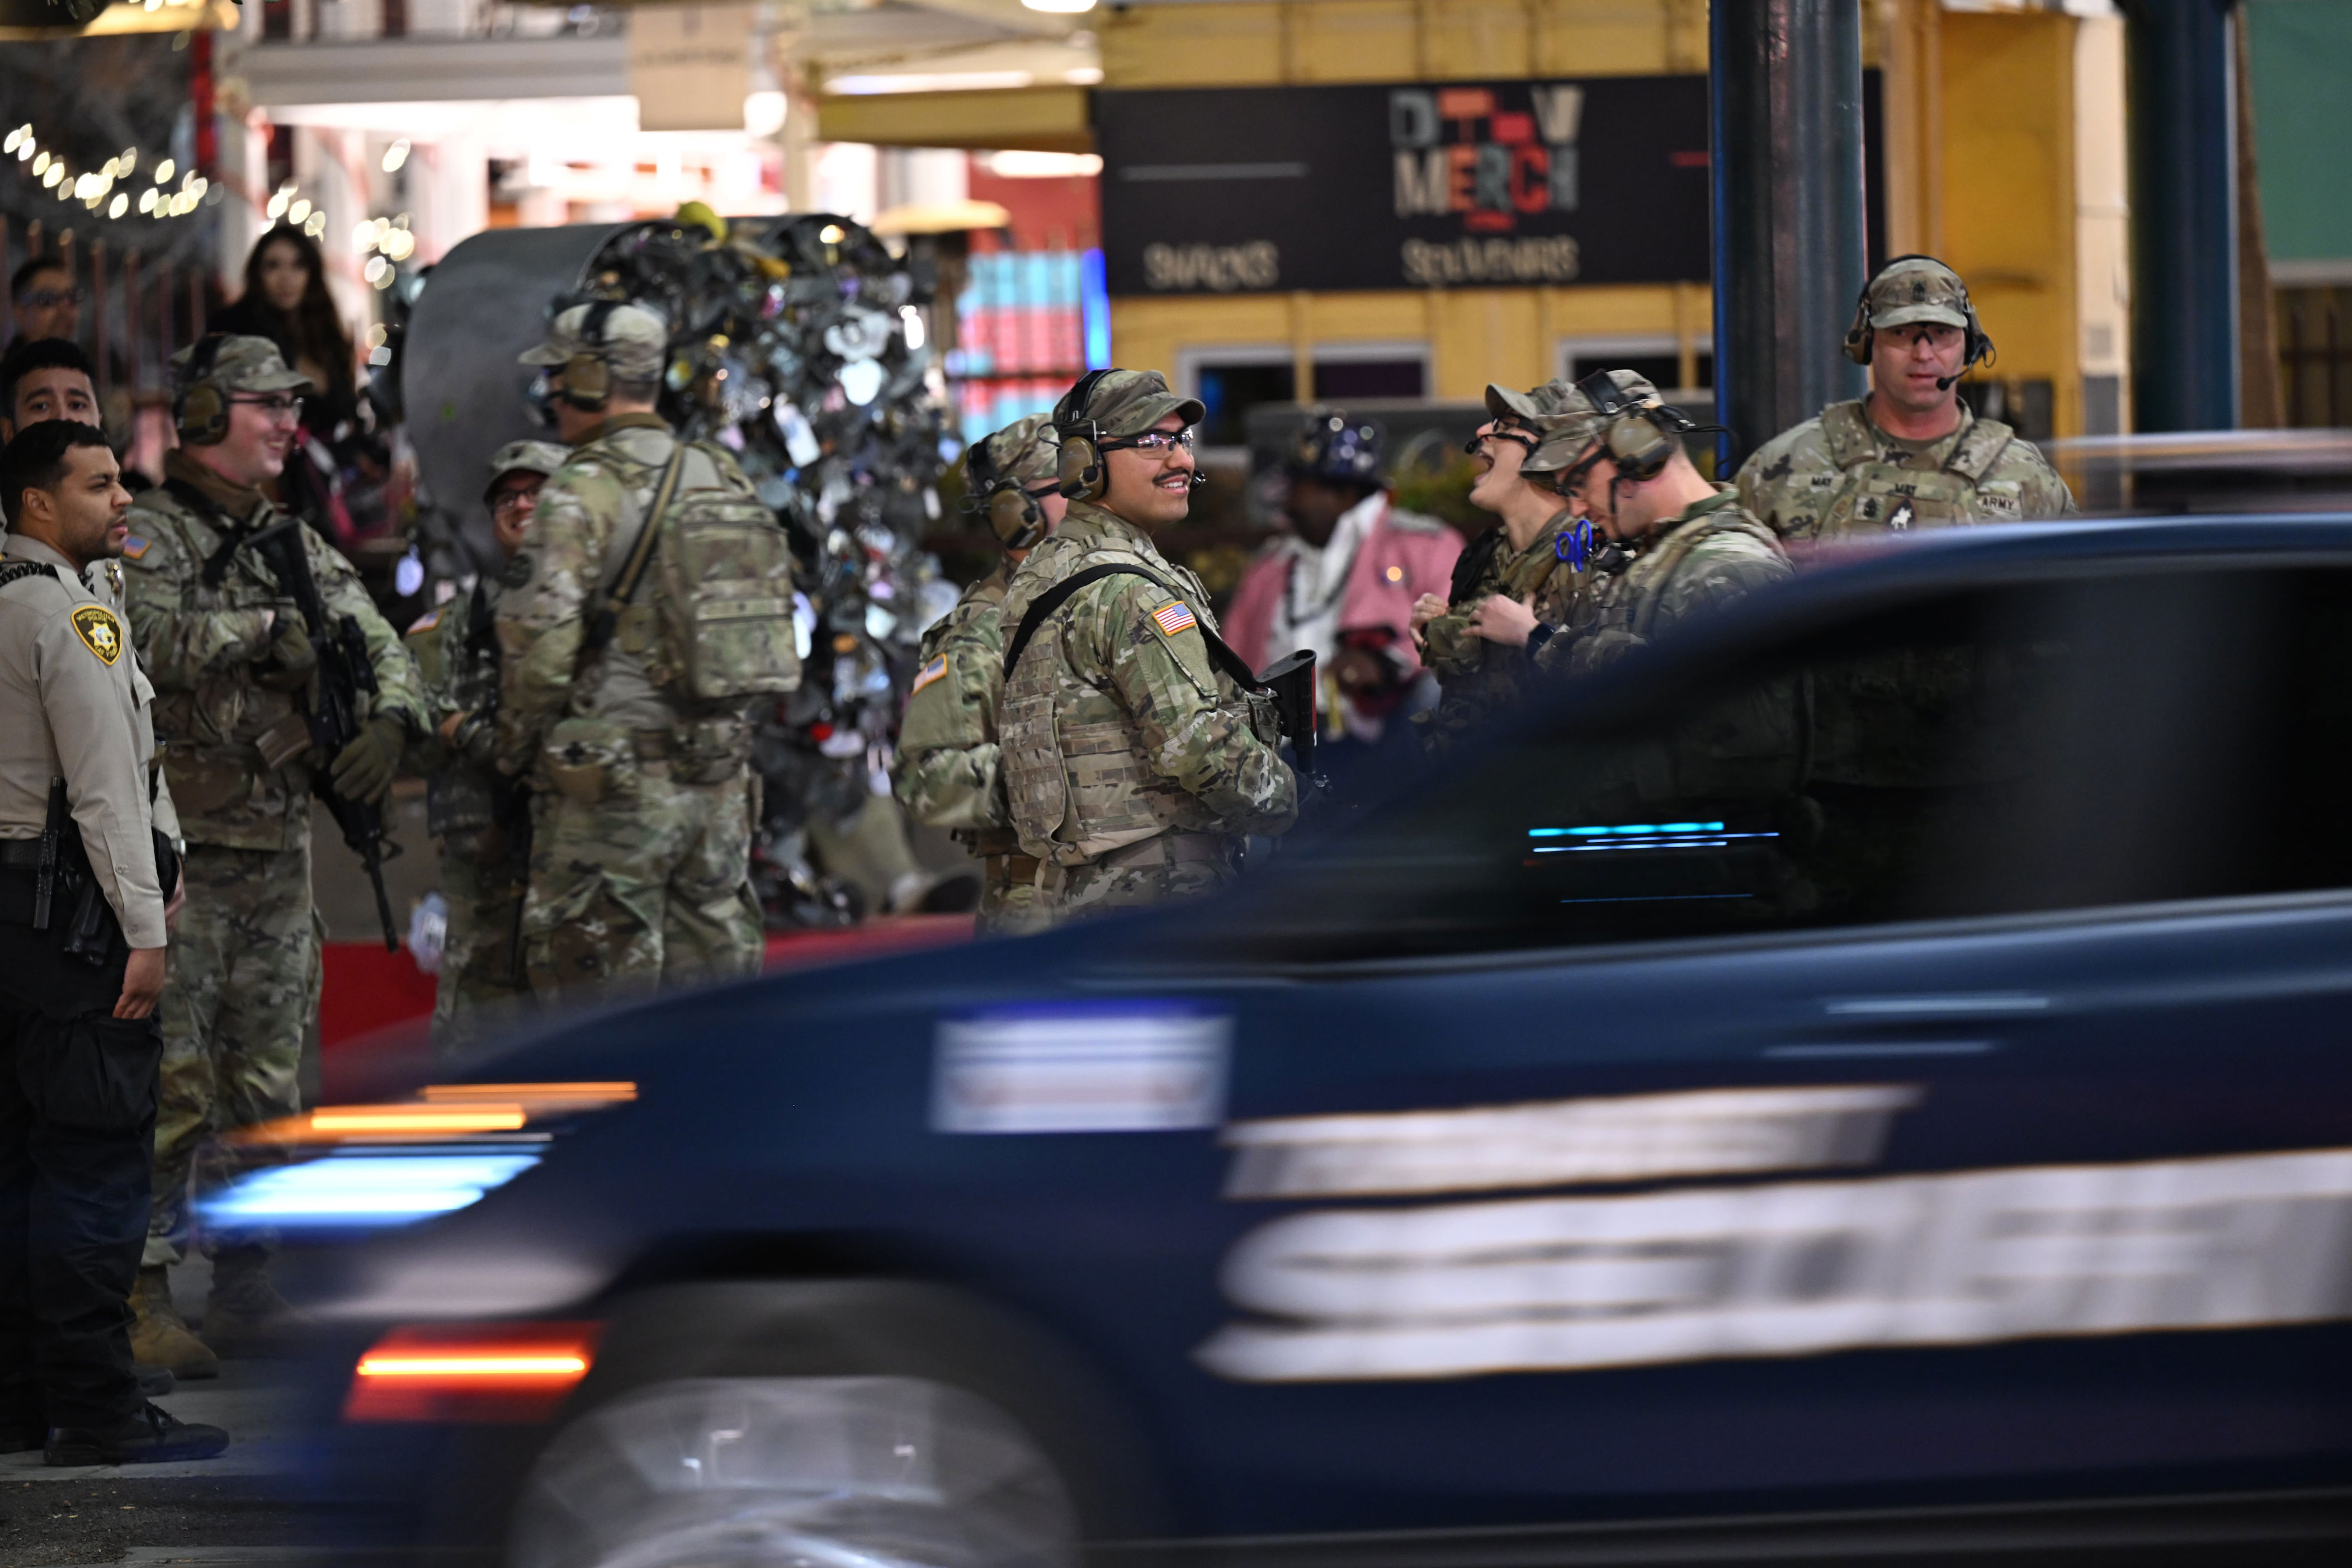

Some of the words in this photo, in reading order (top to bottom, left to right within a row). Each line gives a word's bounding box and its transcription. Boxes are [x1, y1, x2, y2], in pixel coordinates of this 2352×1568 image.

[1395, 144, 1578, 217] MERCH
[1144, 241, 1278, 290] SNACKS
[1402, 234, 1579, 284] SOUVENIRS
[1983, 497, 2014, 510] ARMY
